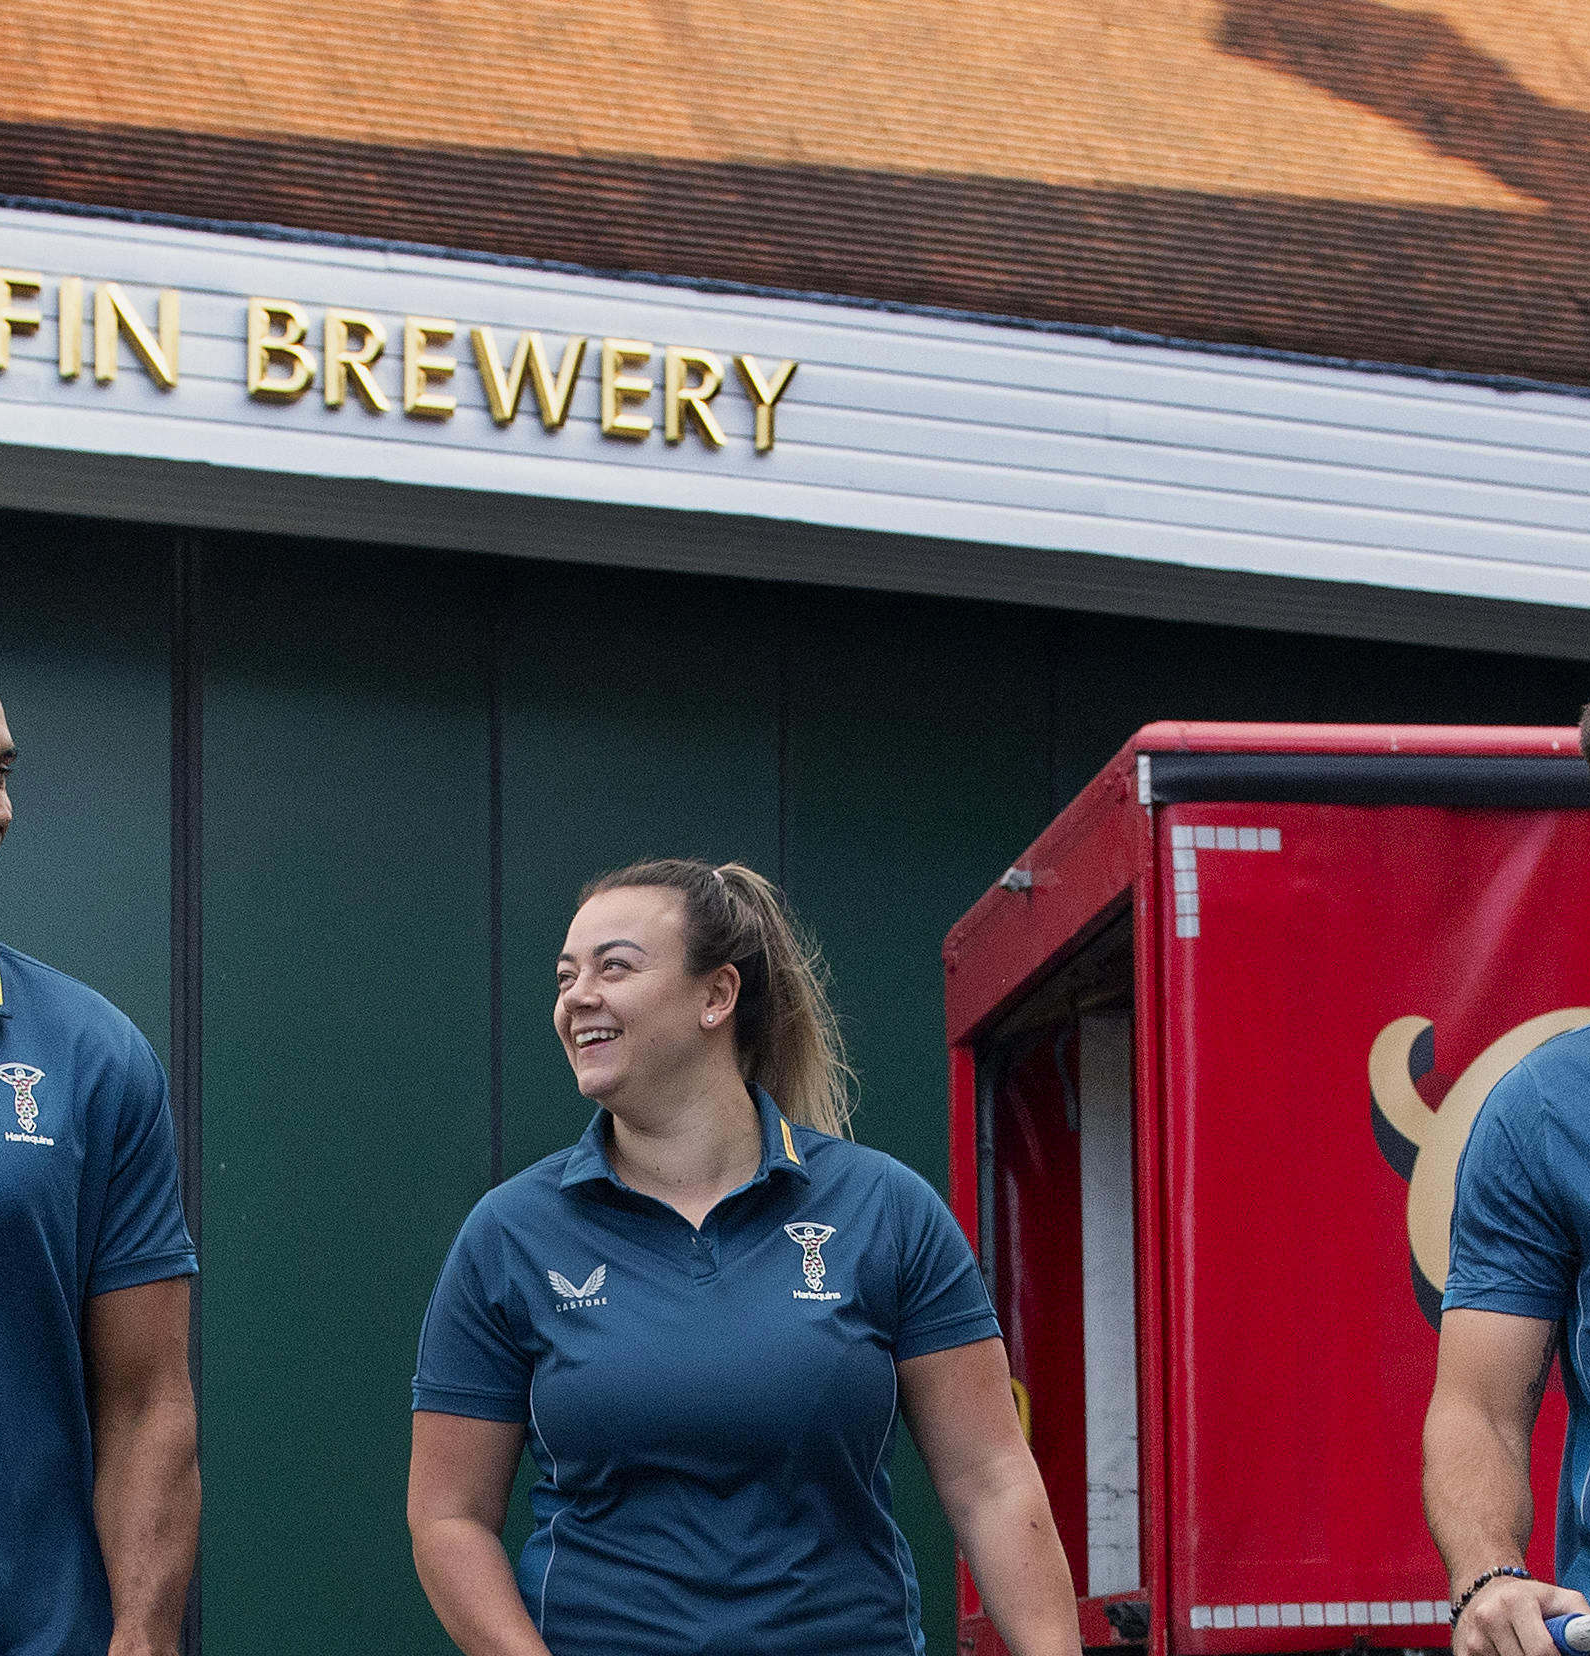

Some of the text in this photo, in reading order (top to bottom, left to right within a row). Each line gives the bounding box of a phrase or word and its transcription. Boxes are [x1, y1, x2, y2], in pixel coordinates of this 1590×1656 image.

[247, 295, 800, 452] BREWERY
[4, 1131, 55, 1146] Harlequins
[792, 1290, 842, 1302] Harlequins
[555, 1297, 608, 1313] CASTORE
